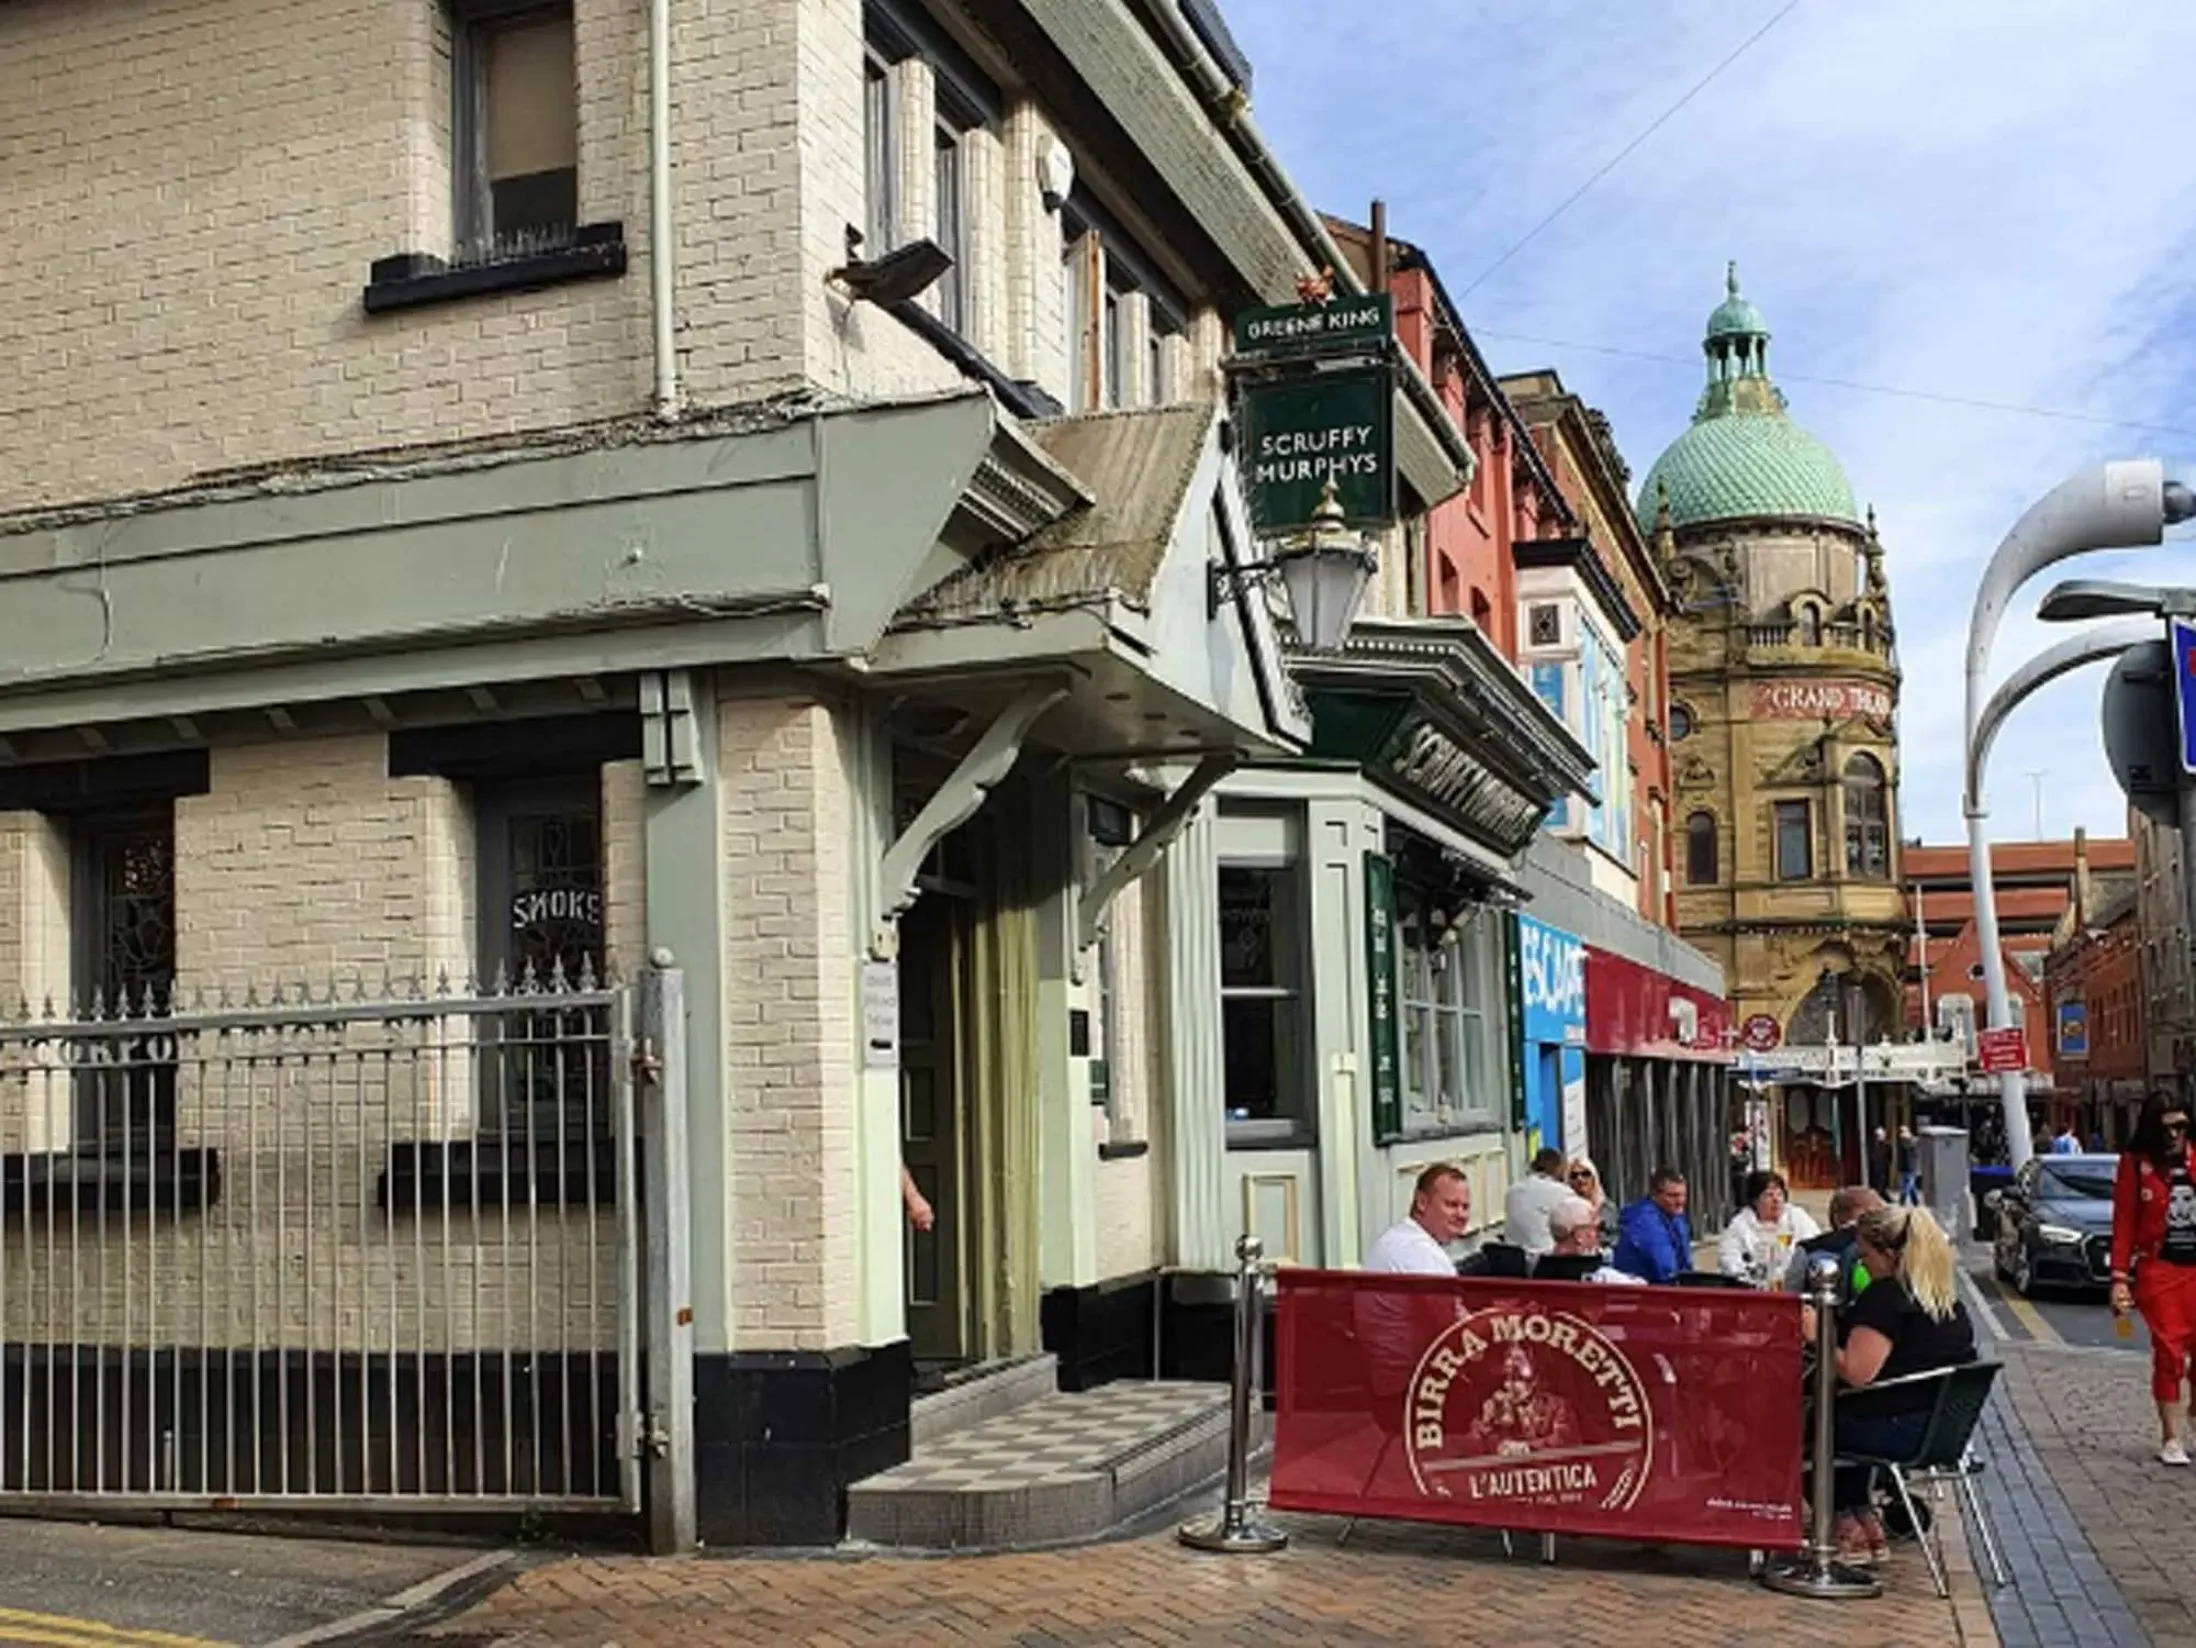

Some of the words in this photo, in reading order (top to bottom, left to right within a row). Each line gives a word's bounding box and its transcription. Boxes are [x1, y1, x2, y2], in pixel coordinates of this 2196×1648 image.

[1248, 312, 1324, 340] GREENE
[1328, 306, 1380, 330] KING
[1261, 424, 1373, 456] SCRUFFY
[1255, 452, 1378, 483] MURPHYS
[1771, 685, 1845, 709] GRAND
[512, 889, 601, 929] SMOKE
[1416, 1327, 1489, 1449] BIRRA
[1490, 1314, 1642, 1429] MORETTI
[1469, 1461, 1598, 1499] L'AUTENTICA
